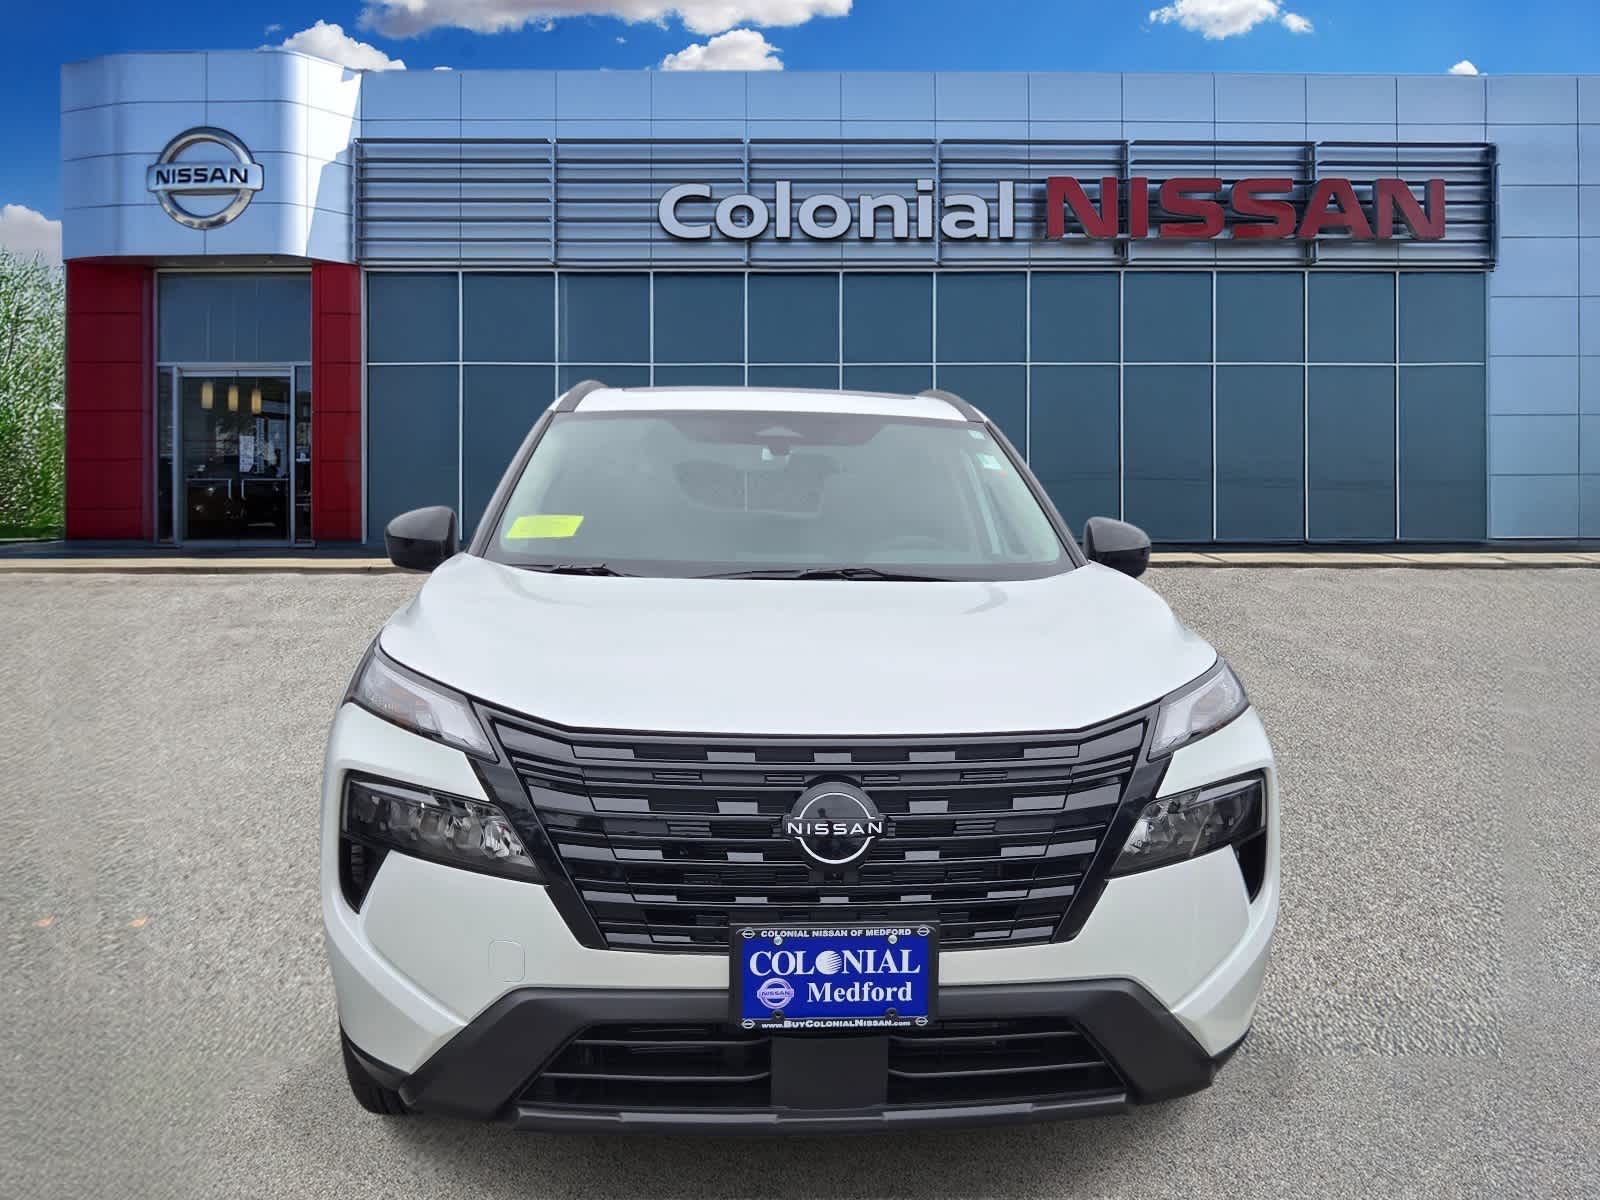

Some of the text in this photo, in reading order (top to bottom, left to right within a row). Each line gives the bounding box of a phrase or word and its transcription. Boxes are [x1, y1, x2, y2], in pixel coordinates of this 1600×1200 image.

[155, 167, 248, 185] NISSAN
[658, 176, 1446, 241] Colonial NISSAN
[787, 821, 883, 835] NISSAN
[760, 930, 810, 938] COLONIAL
[811, 929, 848, 938] NISSAN
[850, 929, 864, 937] OF
[865, 928, 912, 937] MEDFORD
[806, 981, 913, 1003] Medford
